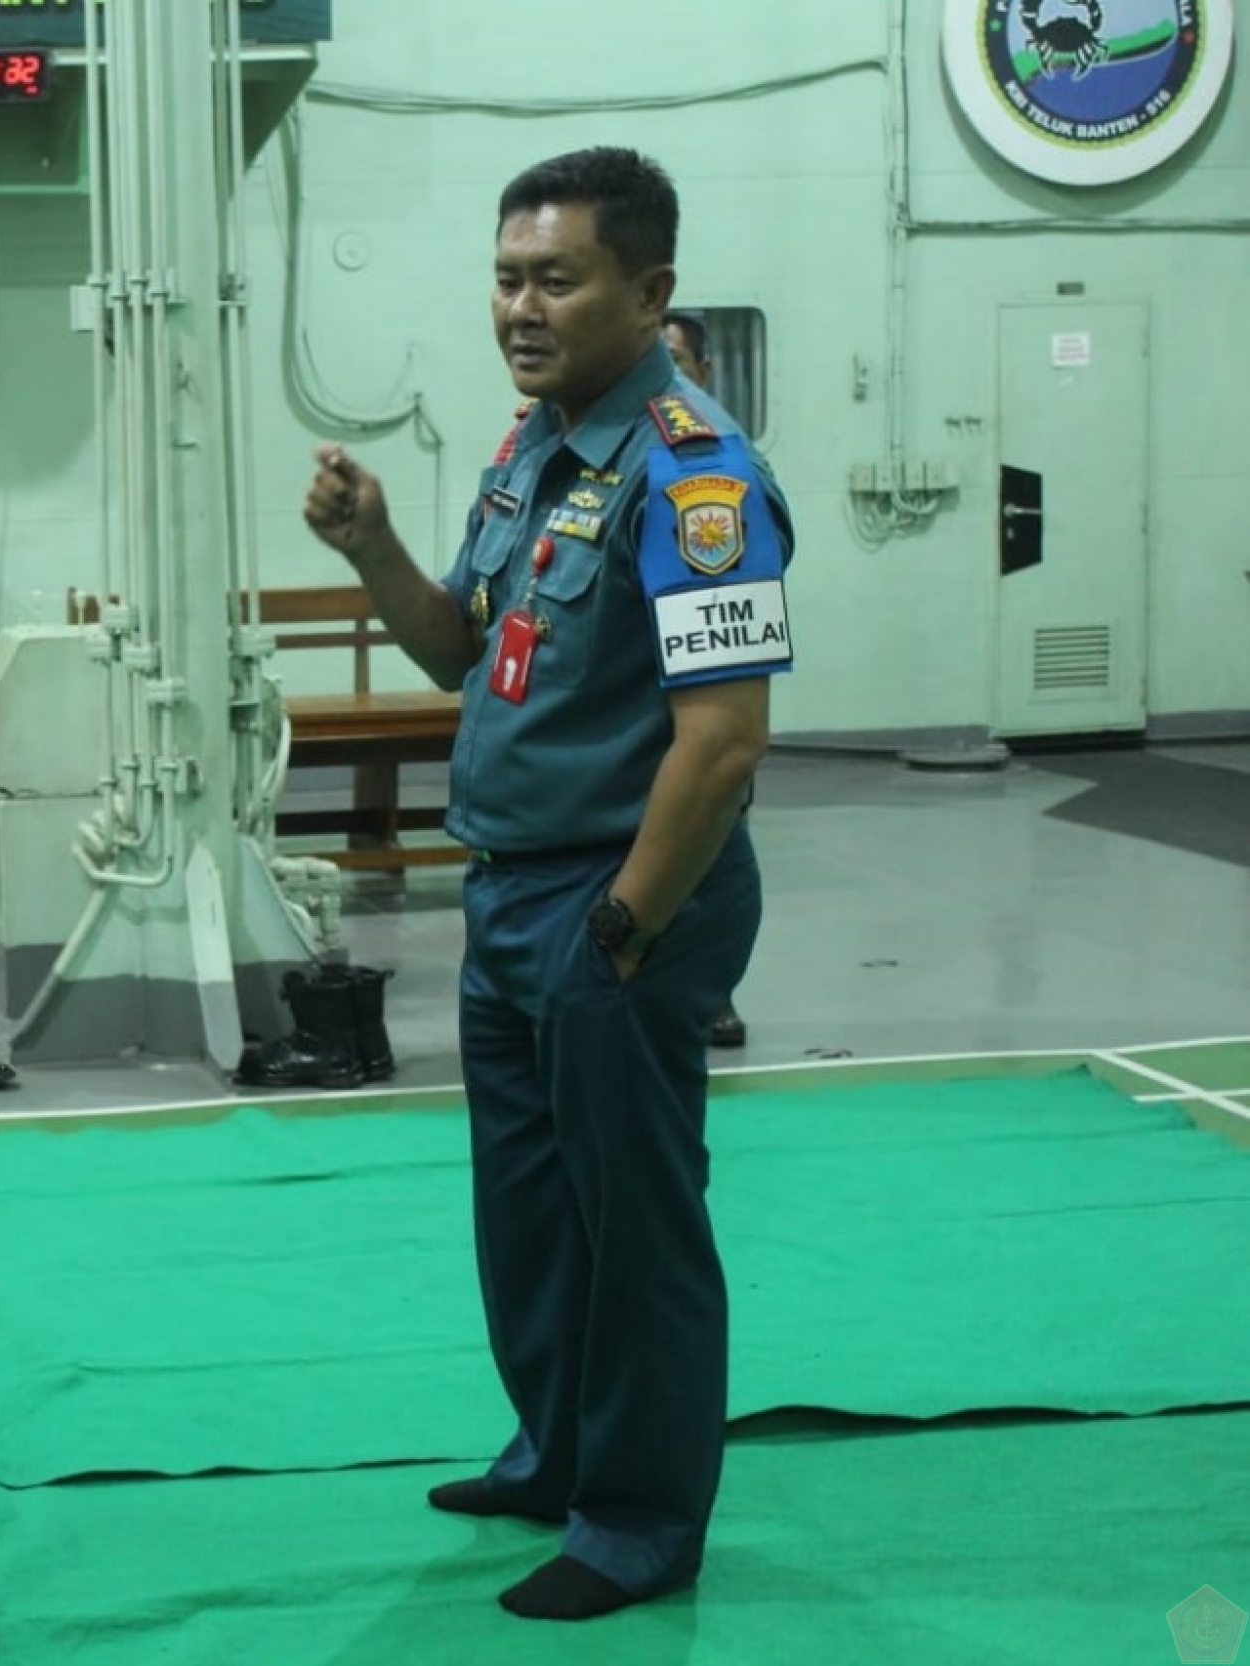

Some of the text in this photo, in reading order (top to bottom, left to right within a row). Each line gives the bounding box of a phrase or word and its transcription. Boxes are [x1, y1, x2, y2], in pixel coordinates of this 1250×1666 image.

[1027, 104, 1074, 137] TELUK
[1076, 114, 1139, 138] BANTEN
[695, 599, 754, 626] TIM
[665, 621, 786, 659] PENILAI
